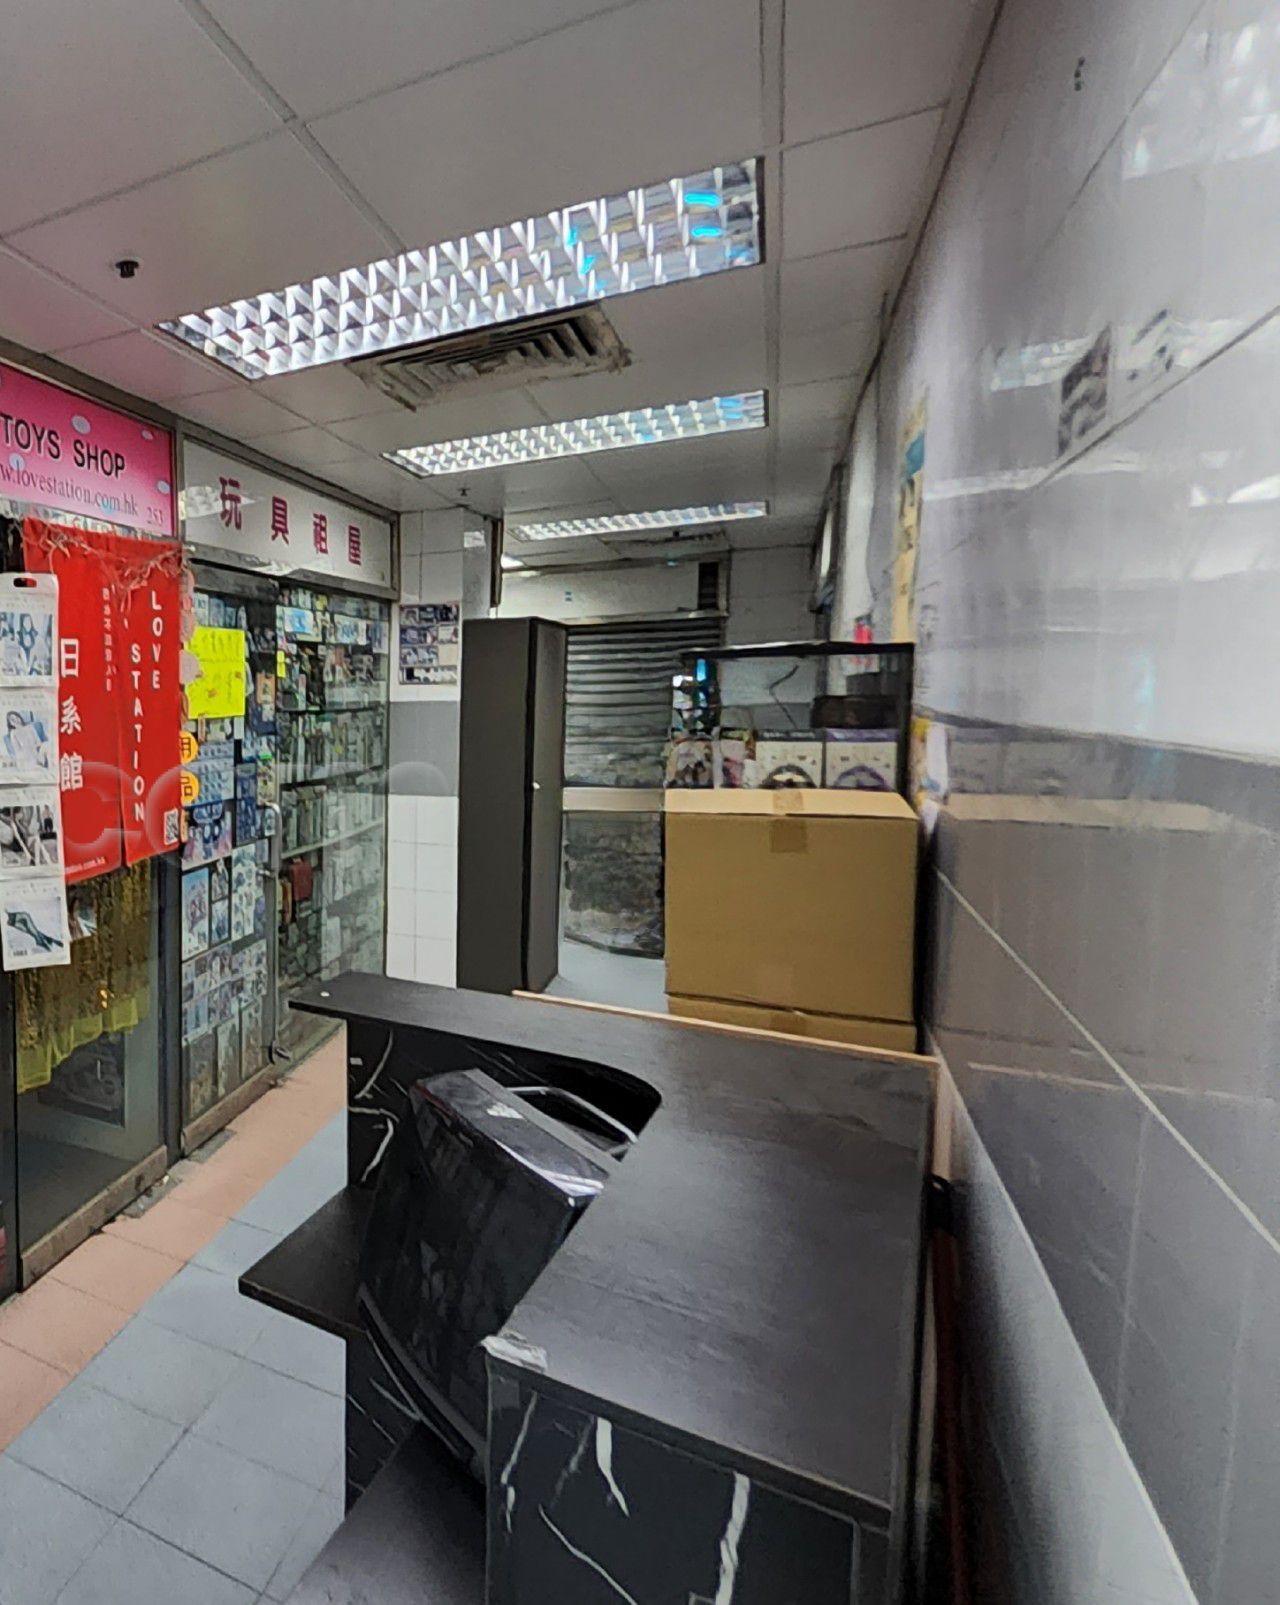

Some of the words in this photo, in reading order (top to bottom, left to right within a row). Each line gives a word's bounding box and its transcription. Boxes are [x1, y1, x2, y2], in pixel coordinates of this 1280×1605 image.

[0, 412, 61, 462] TOYS
[73, 438, 126, 479] SHOP
[151, 589, 163, 690] LOVE
[60, 637, 84, 793] 日系館
[130, 642, 145, 822] STATION
